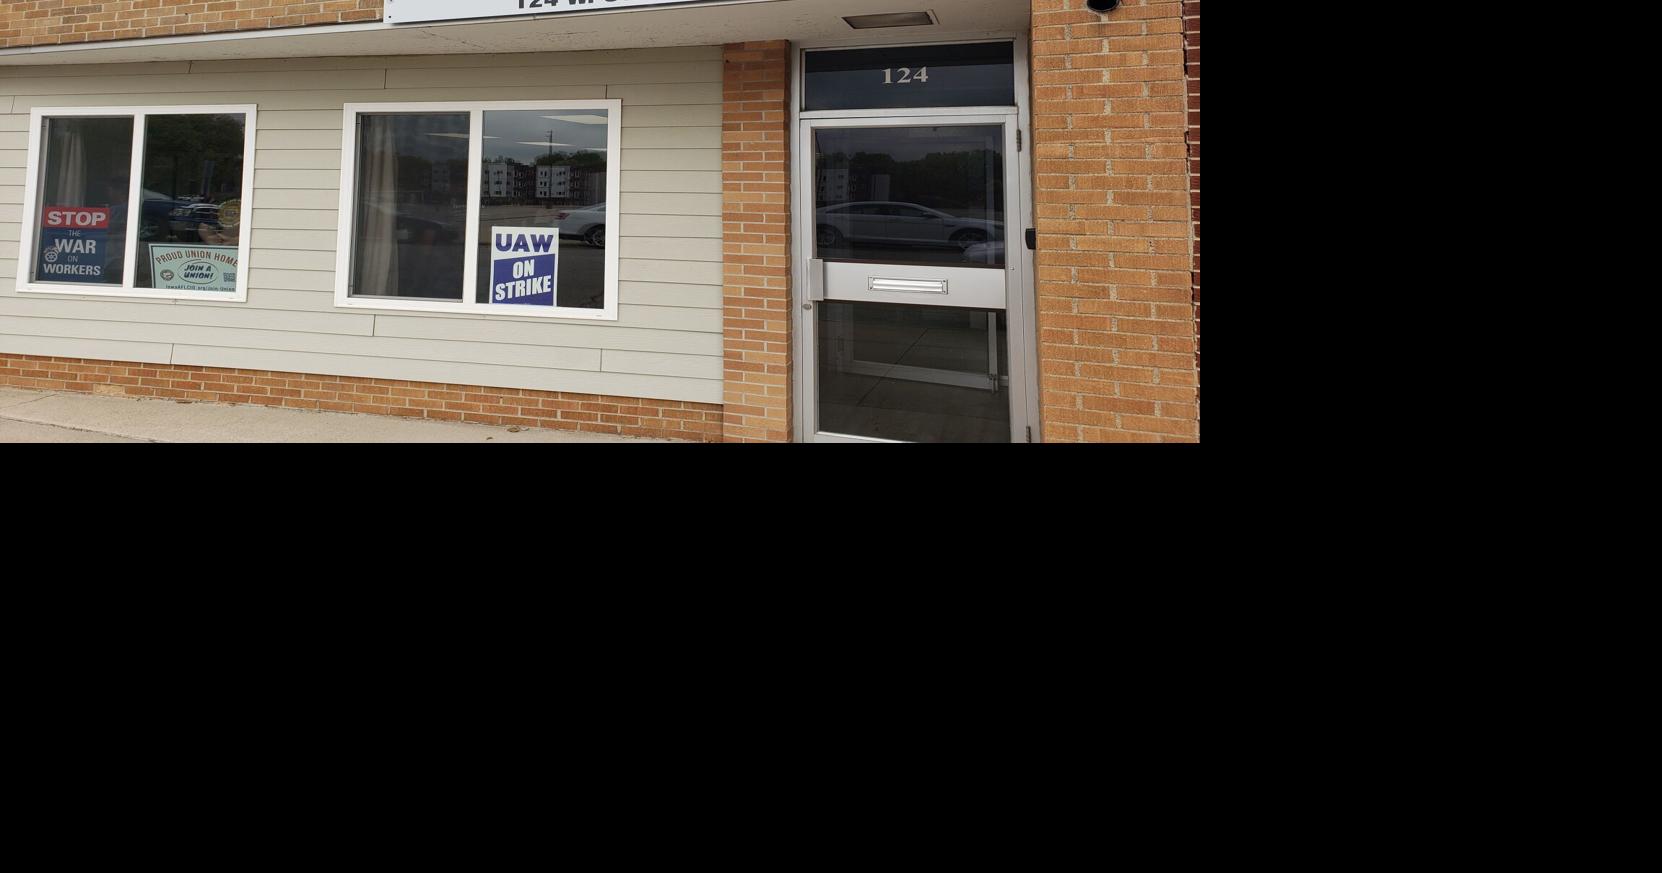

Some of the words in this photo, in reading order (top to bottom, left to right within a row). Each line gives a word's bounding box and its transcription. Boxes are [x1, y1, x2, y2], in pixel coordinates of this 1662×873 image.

[881, 66, 929, 84] 124
[47, 211, 106, 226] STOP
[67, 229, 81, 237] THE
[54, 238, 97, 254] WAR
[495, 233, 554, 253] UAW
[67, 255, 79, 263] ON
[155, 250, 184, 265] PROUD
[185, 249, 211, 259] UNION
[214, 252, 238, 268] HOME
[43, 263, 101, 276] WORKERS
[183, 271, 214, 280] UNION!
[184, 264, 204, 272] JOIN
[512, 259, 535, 279] ON
[495, 275, 552, 301] STRIKE
